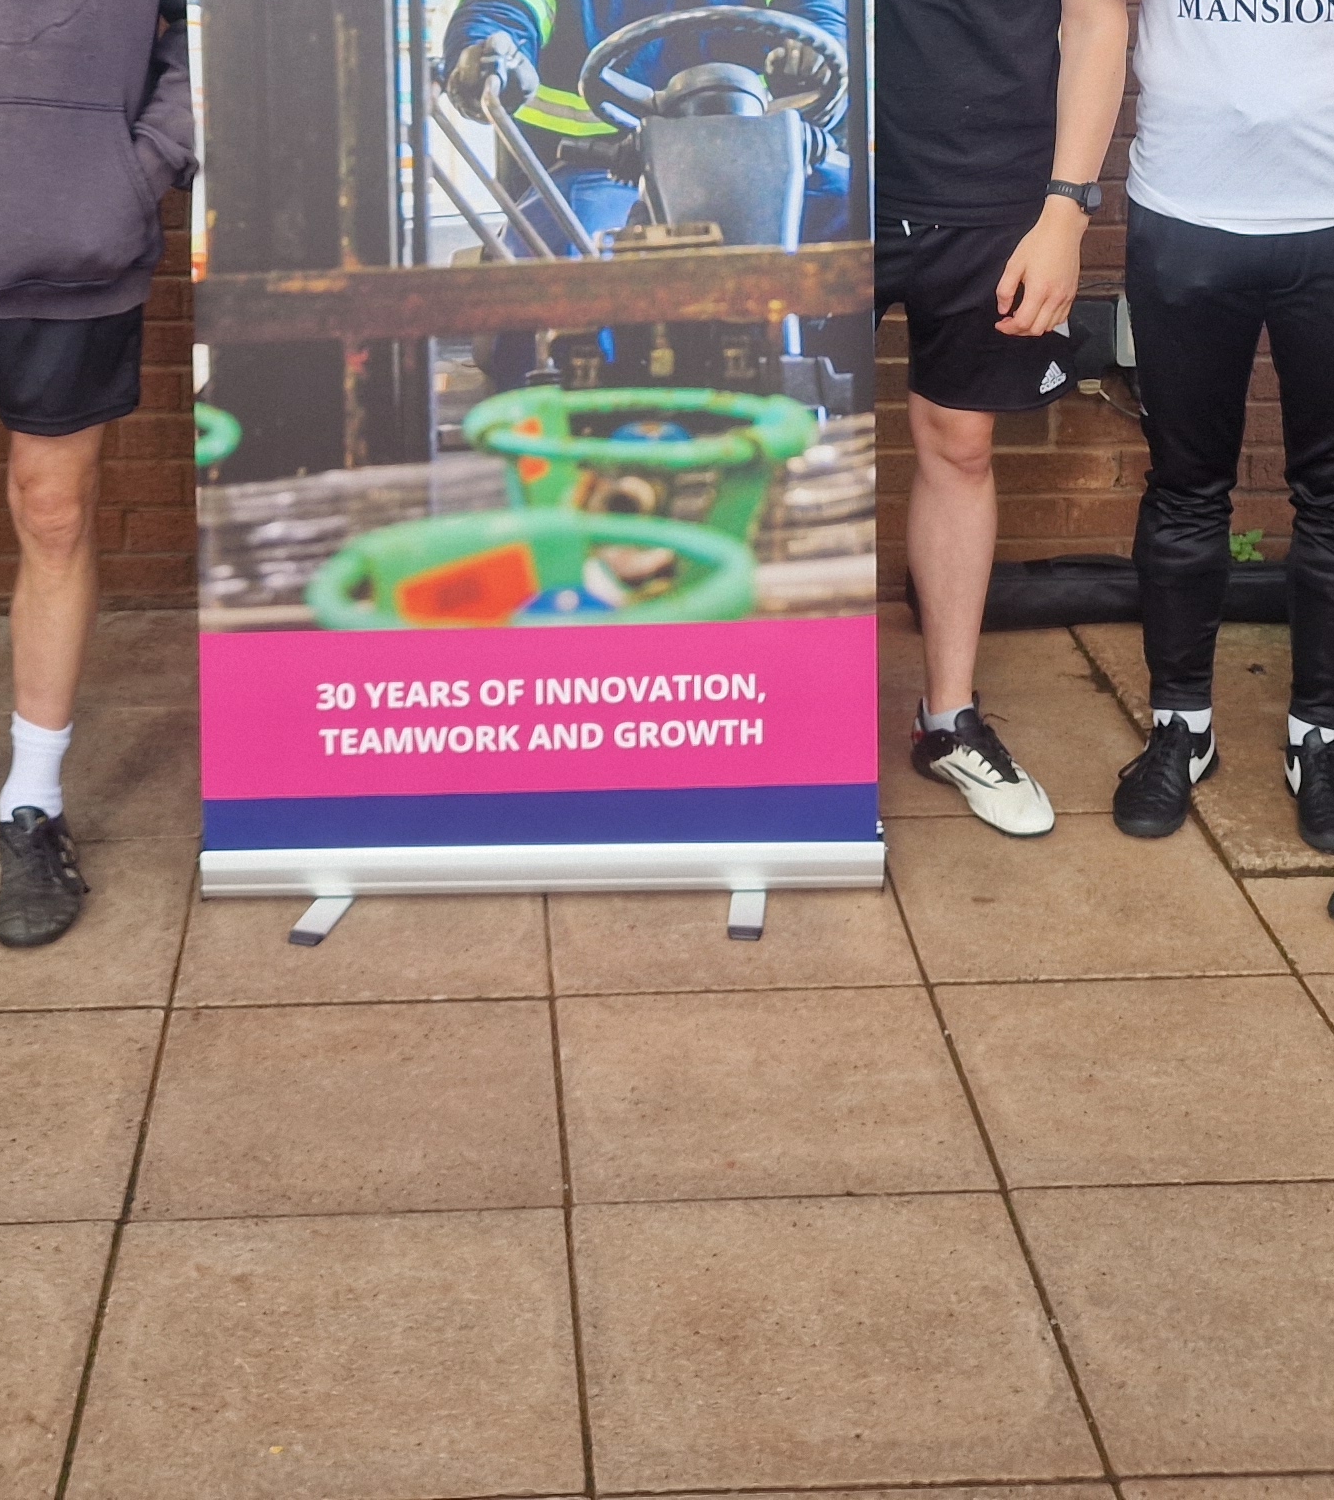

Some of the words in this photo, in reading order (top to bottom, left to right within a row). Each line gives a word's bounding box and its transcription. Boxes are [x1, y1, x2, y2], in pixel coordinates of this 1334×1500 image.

[315, 683, 355, 711] 30
[364, 680, 470, 709] YEARS
[478, 679, 525, 706] OF
[534, 673, 768, 704] INNOVATION,
[318, 723, 521, 756] TEAMWORK
[528, 722, 605, 750] AND
[613, 718, 764, 748] GROWTH
